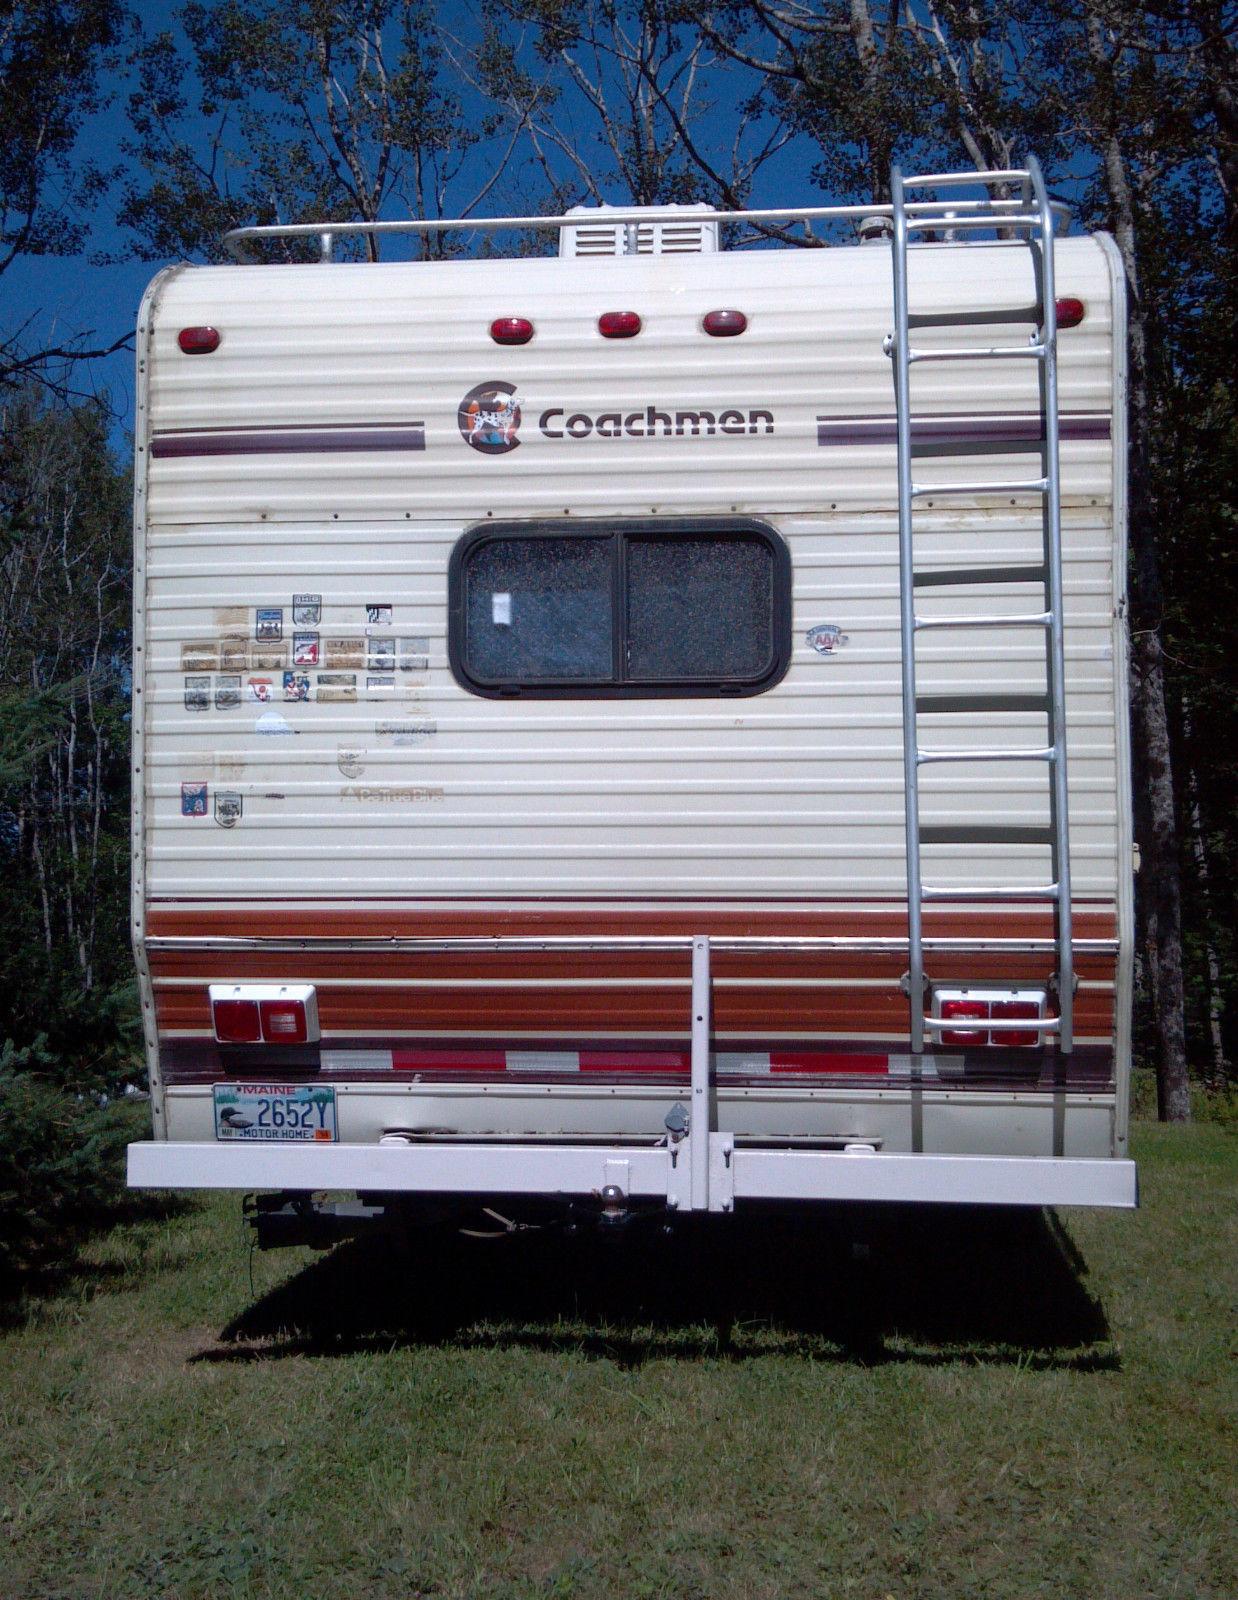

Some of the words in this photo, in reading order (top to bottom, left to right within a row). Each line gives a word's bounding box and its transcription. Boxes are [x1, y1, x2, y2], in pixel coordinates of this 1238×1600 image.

[539, 405, 774, 439] Coachmen
[243, 1085, 296, 1095] MAINE
[257, 1098, 328, 1129] 2652Y
[243, 1128, 279, 1138] MOTOR
[281, 1129, 310, 1139] HOME
